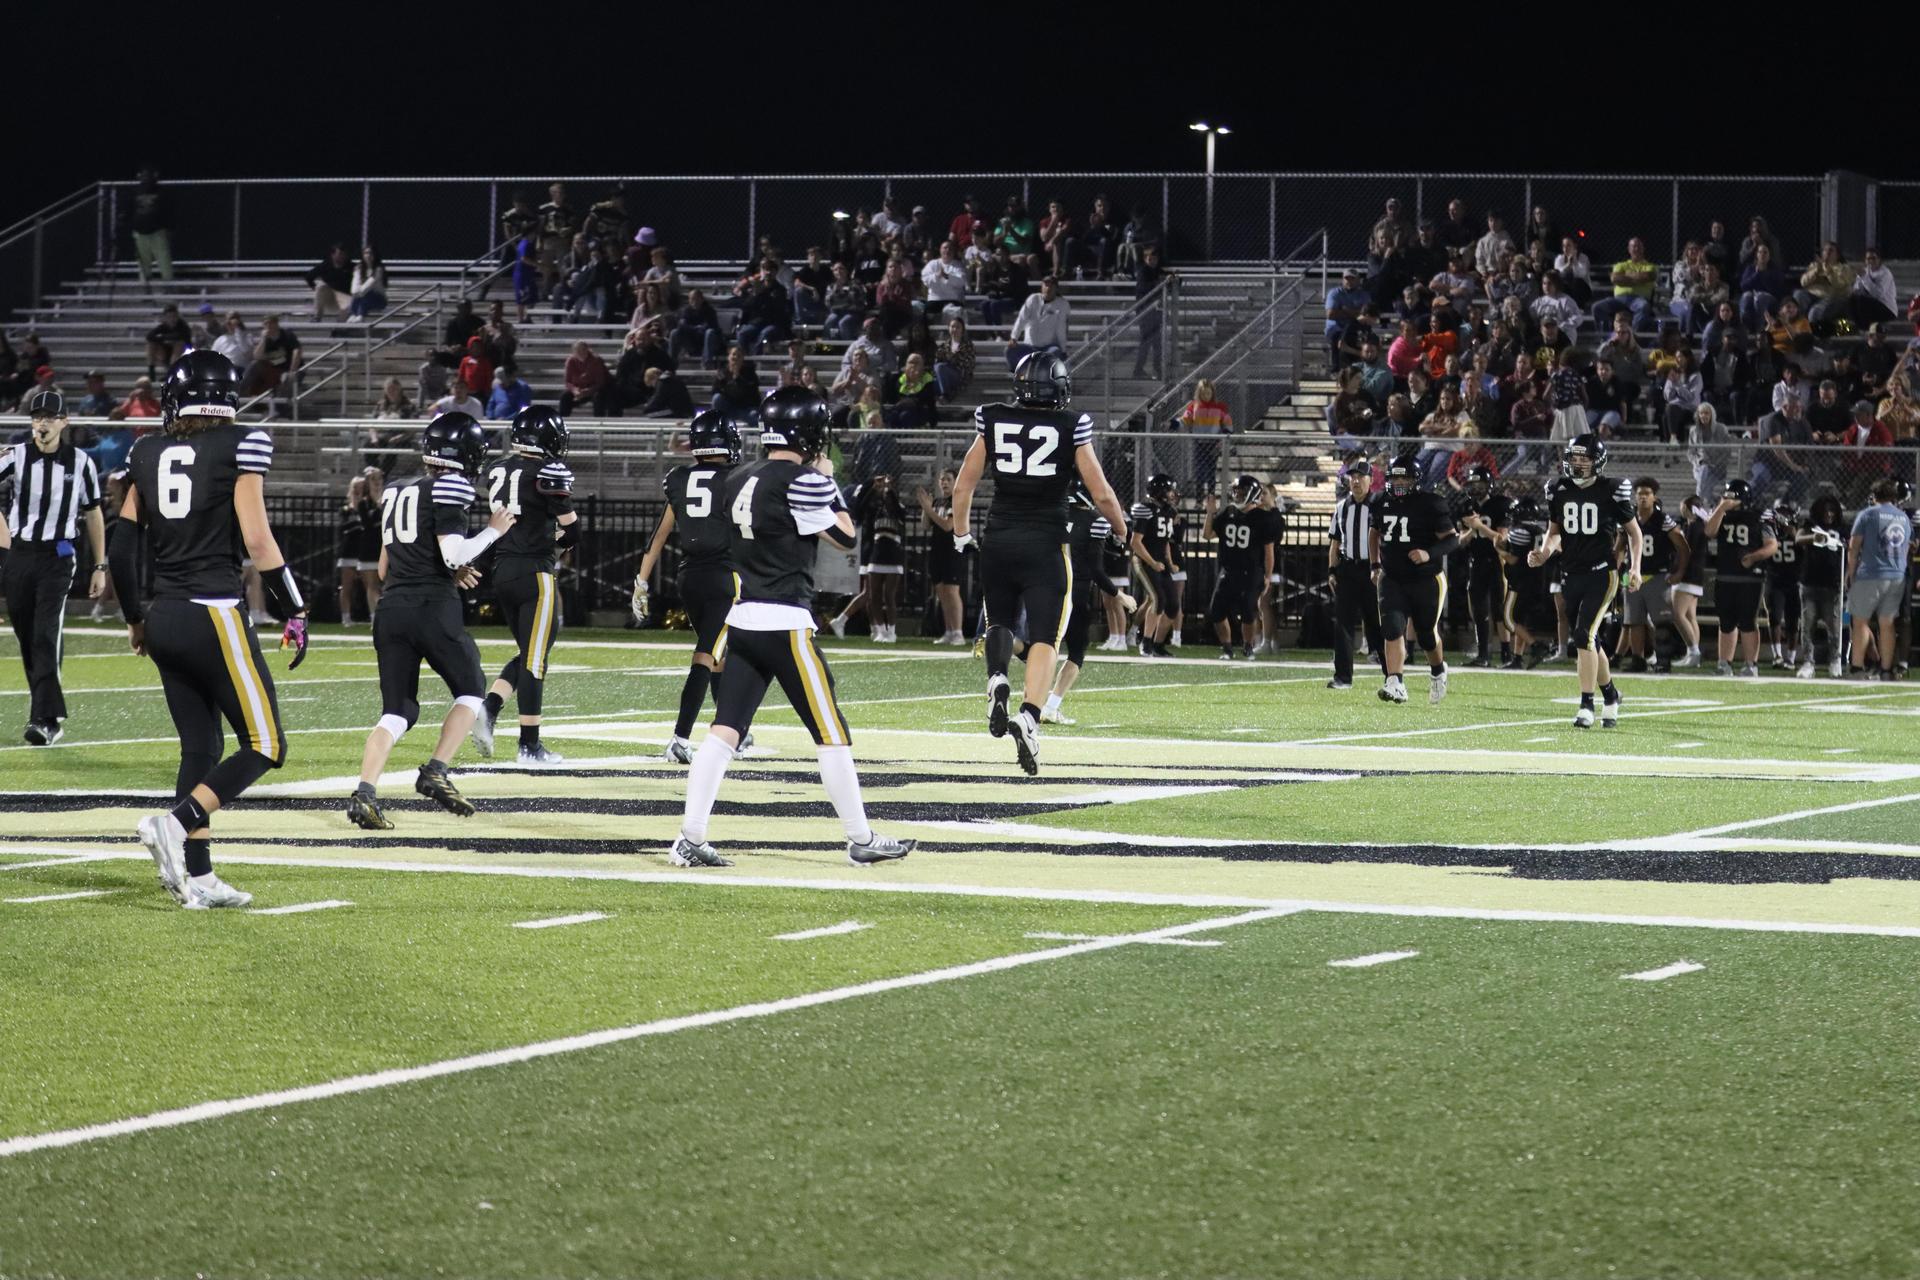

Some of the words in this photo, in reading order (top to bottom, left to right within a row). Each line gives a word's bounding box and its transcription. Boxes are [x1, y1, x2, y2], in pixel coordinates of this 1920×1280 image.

[994, 422, 1059, 476] 52
[158, 445, 196, 519] 6
[488, 467, 523, 515] 21
[686, 471, 717, 518] 5
[381, 485, 420, 546] 20
[731, 476, 760, 540] 4
[1383, 515, 1411, 543] 71
[1563, 502, 1598, 535] 80
[1225, 523, 1251, 549] 99
[1724, 523, 1749, 546] 79
